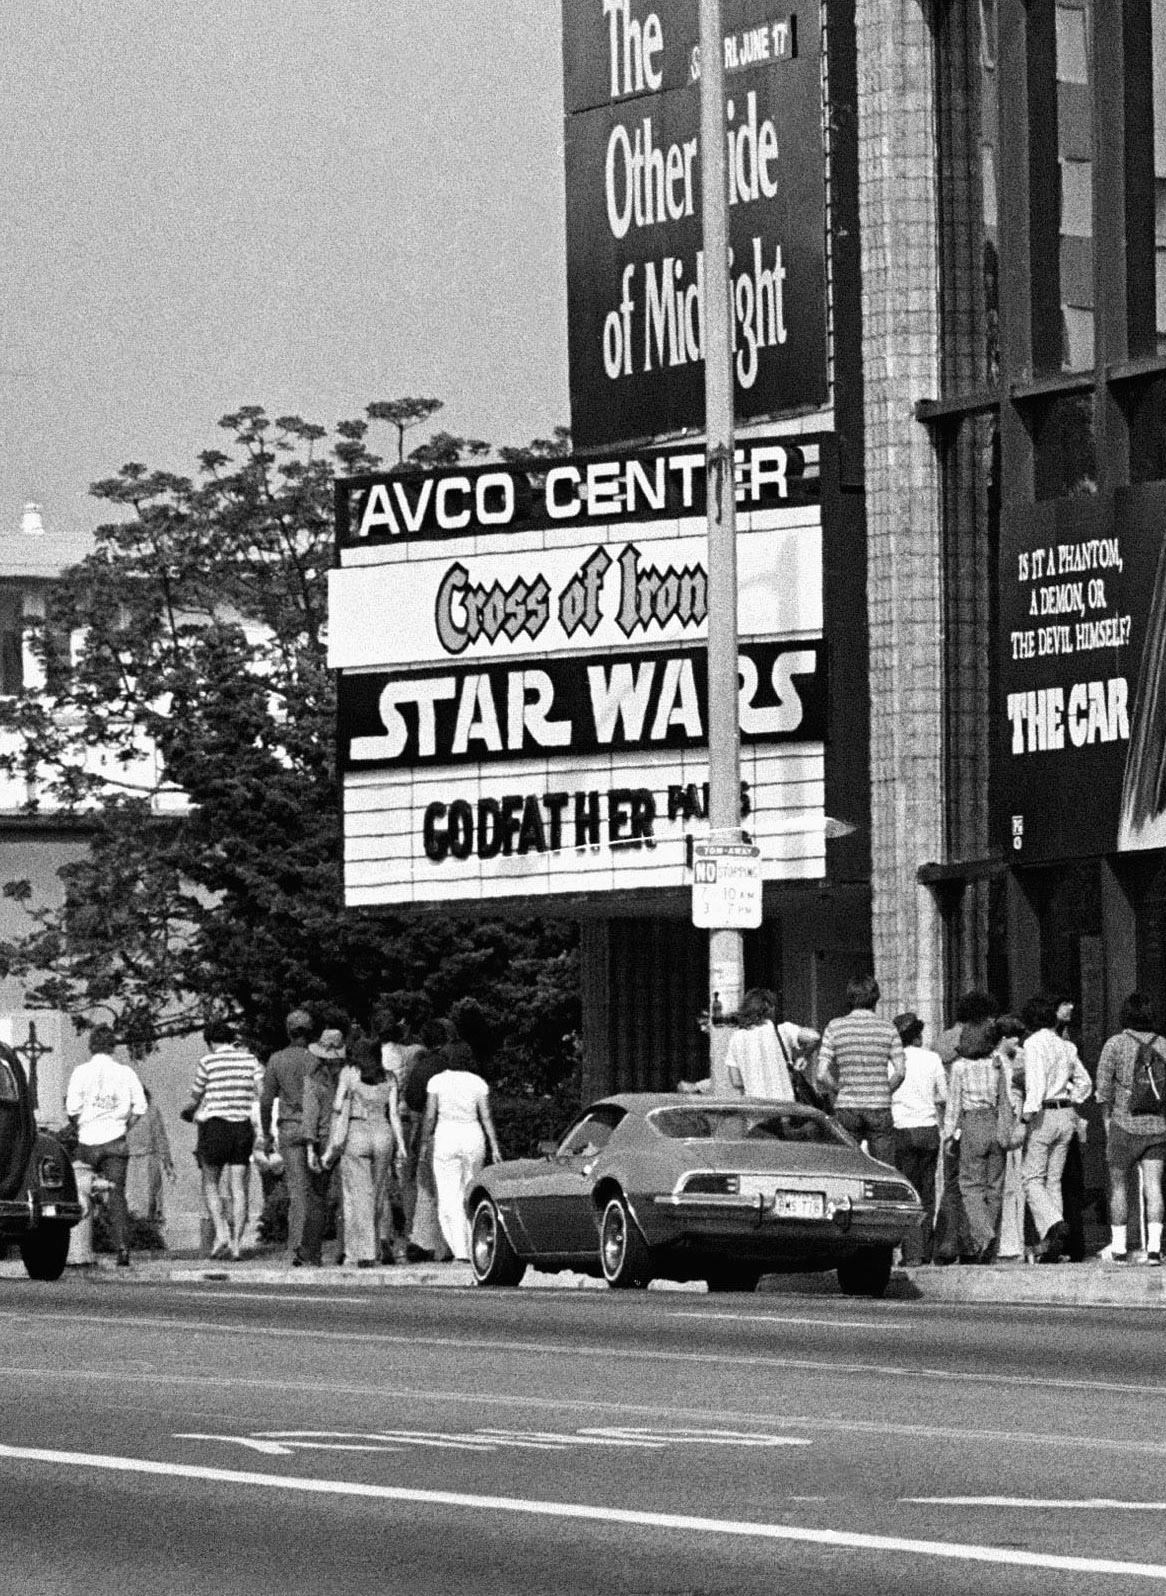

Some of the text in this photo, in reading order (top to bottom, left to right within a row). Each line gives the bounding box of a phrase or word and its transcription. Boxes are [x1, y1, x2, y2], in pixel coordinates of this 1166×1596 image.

[604, 0, 663, 97] The
[740, 27, 769, 65] JUNE
[772, 22, 788, 56] 17
[605, 91, 779, 239] Other ide
[603, 237, 787, 389] of Midight
[358, 472, 515, 537] AVCO
[1018, 537, 1123, 581] IS IT A PHANTOM,
[1029, 578, 1107, 618] A DEMON, OR
[435, 543, 708, 655] Cross of Iron
[1010, 615, 1132, 660] THE DEVIL HIMSELF?
[349, 669, 573, 761] STAR
[1007, 677, 1130, 755] THE CAR
[423, 788, 658, 866] GODFATHER
[696, 863, 716, 882] NO
